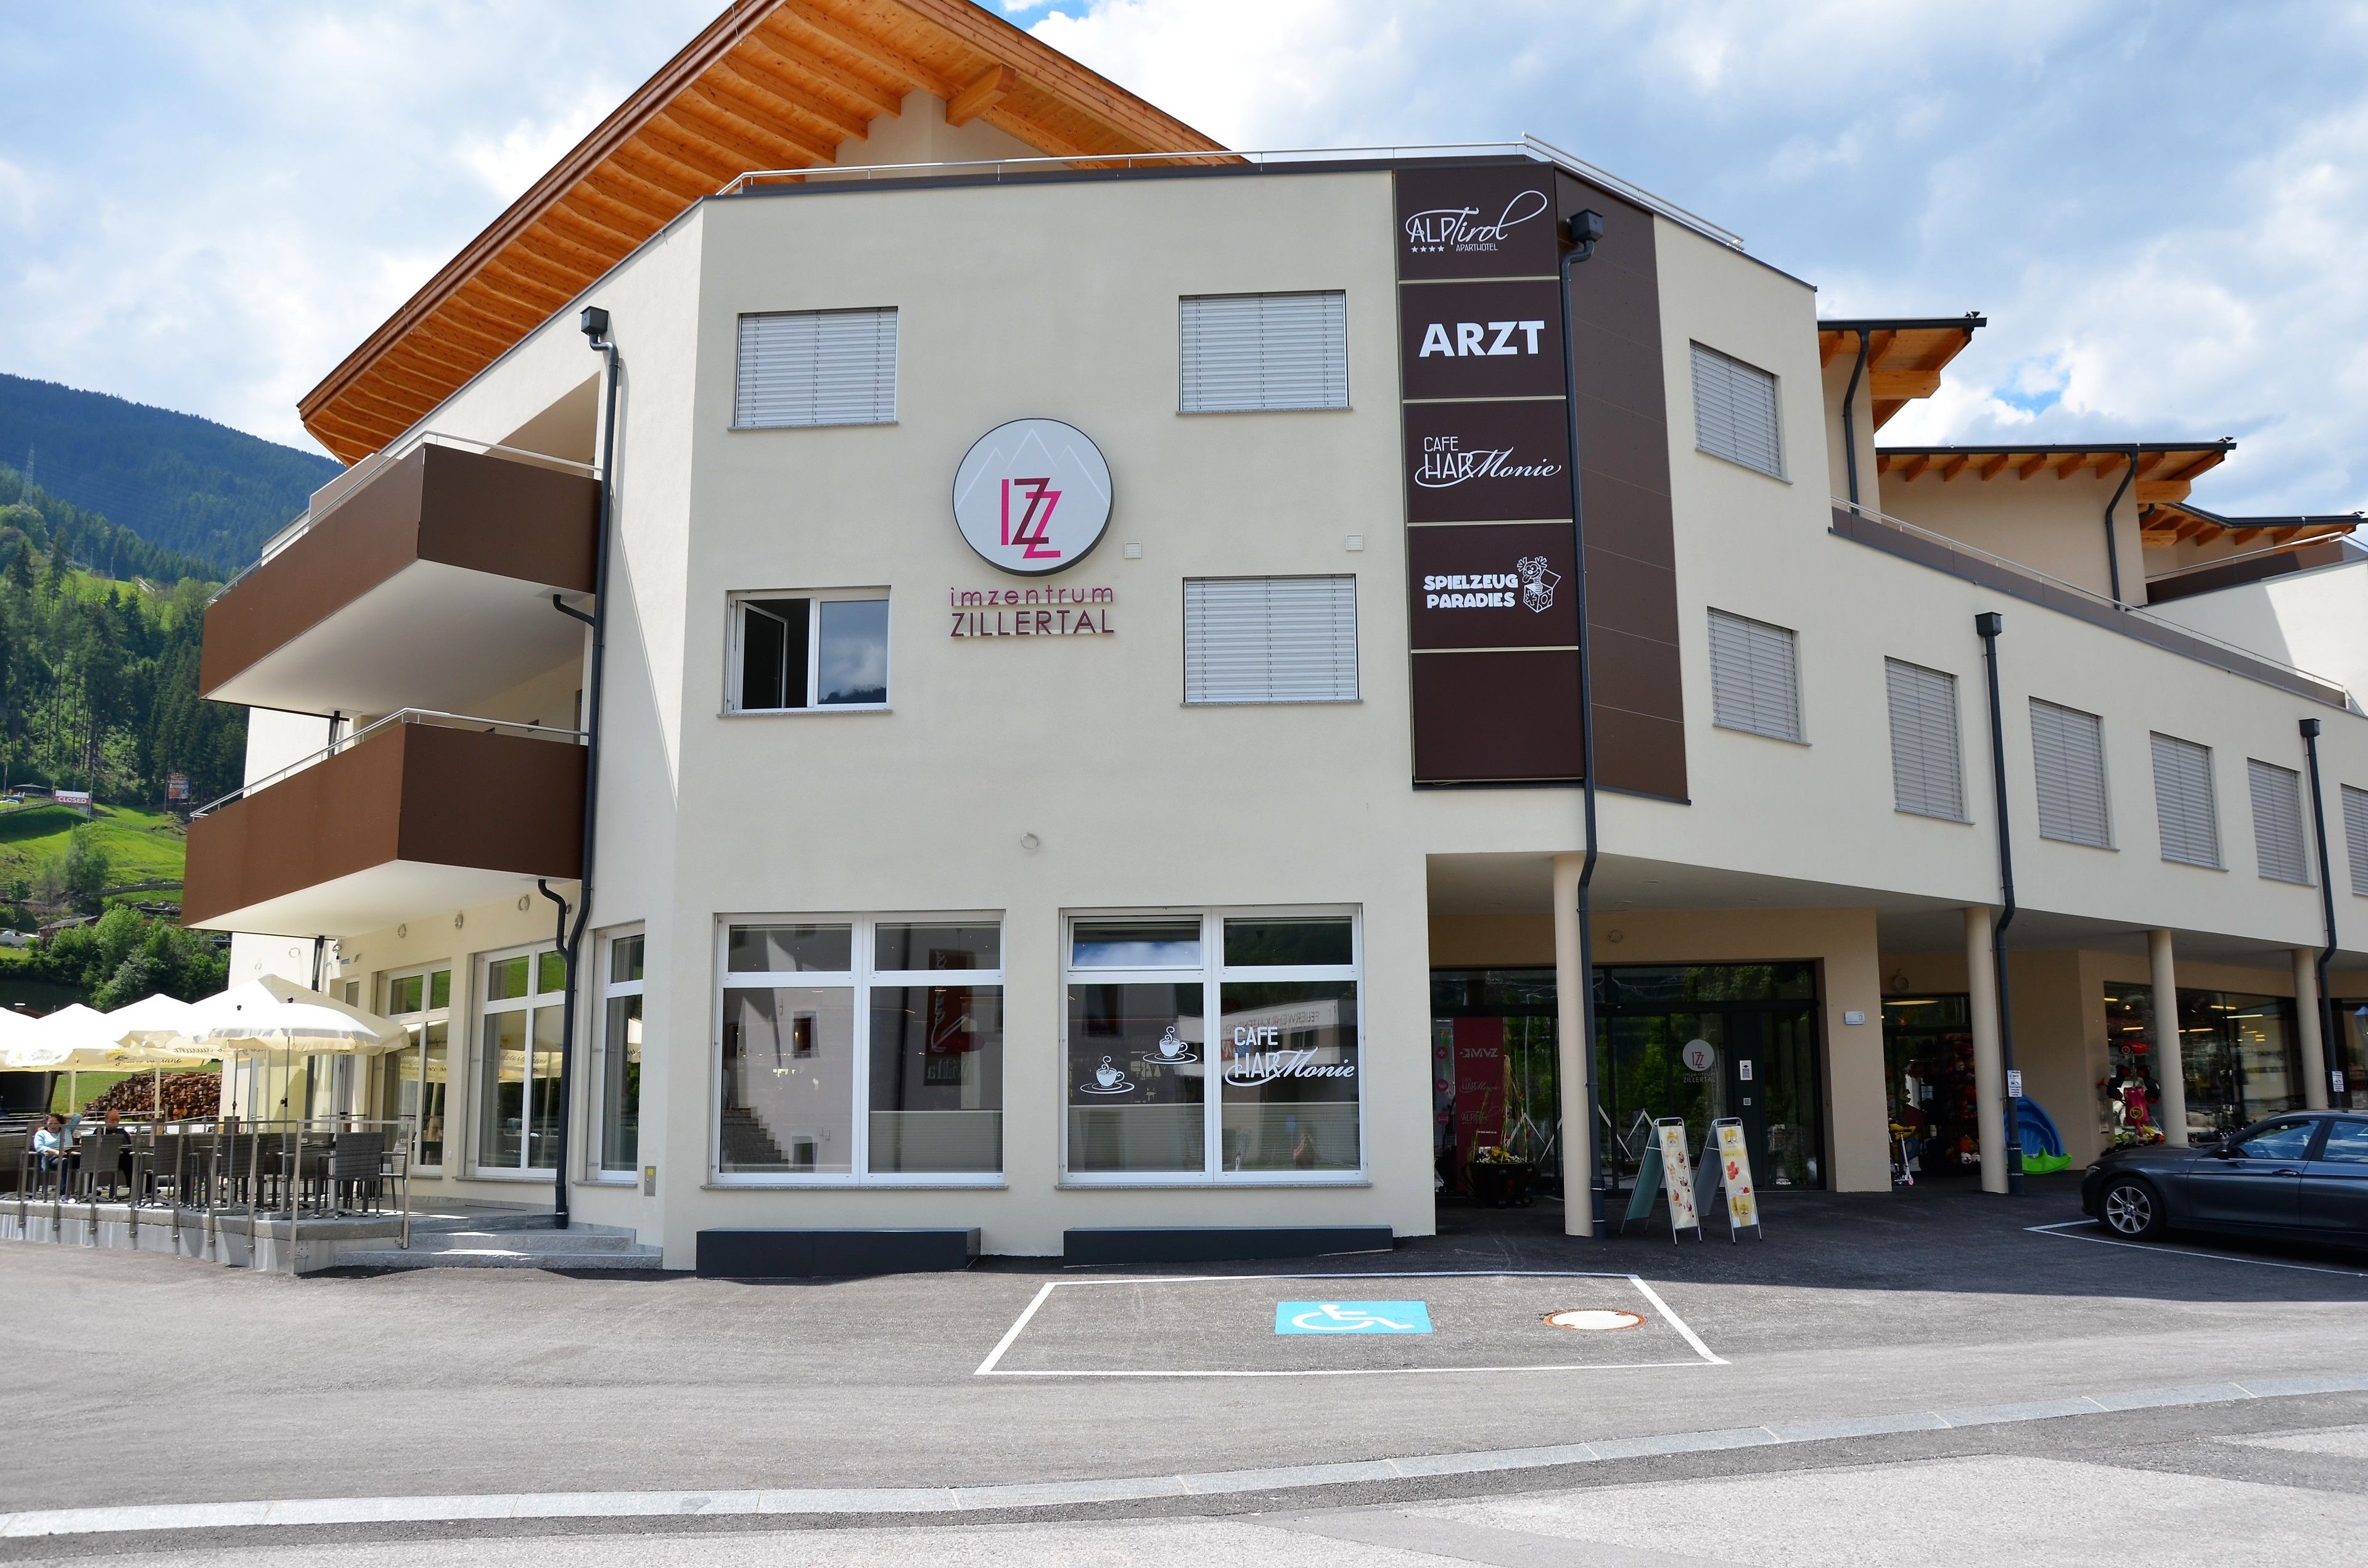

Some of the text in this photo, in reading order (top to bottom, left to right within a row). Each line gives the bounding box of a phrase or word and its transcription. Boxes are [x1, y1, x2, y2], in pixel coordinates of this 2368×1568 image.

[1456, 242, 1498, 252] APARTHOTEL
[1419, 320, 1545, 358] ARZT
[1424, 436, 1459, 452] CAFE
[1423, 573, 1518, 591] SPIELZEUG
[1426, 591, 1516, 609] PARADIES
[950, 609, 1114, 637] ZILLERTAL
[59, 796, 87, 804] CLOSED
[1234, 1026, 1278, 1046] CAFE
